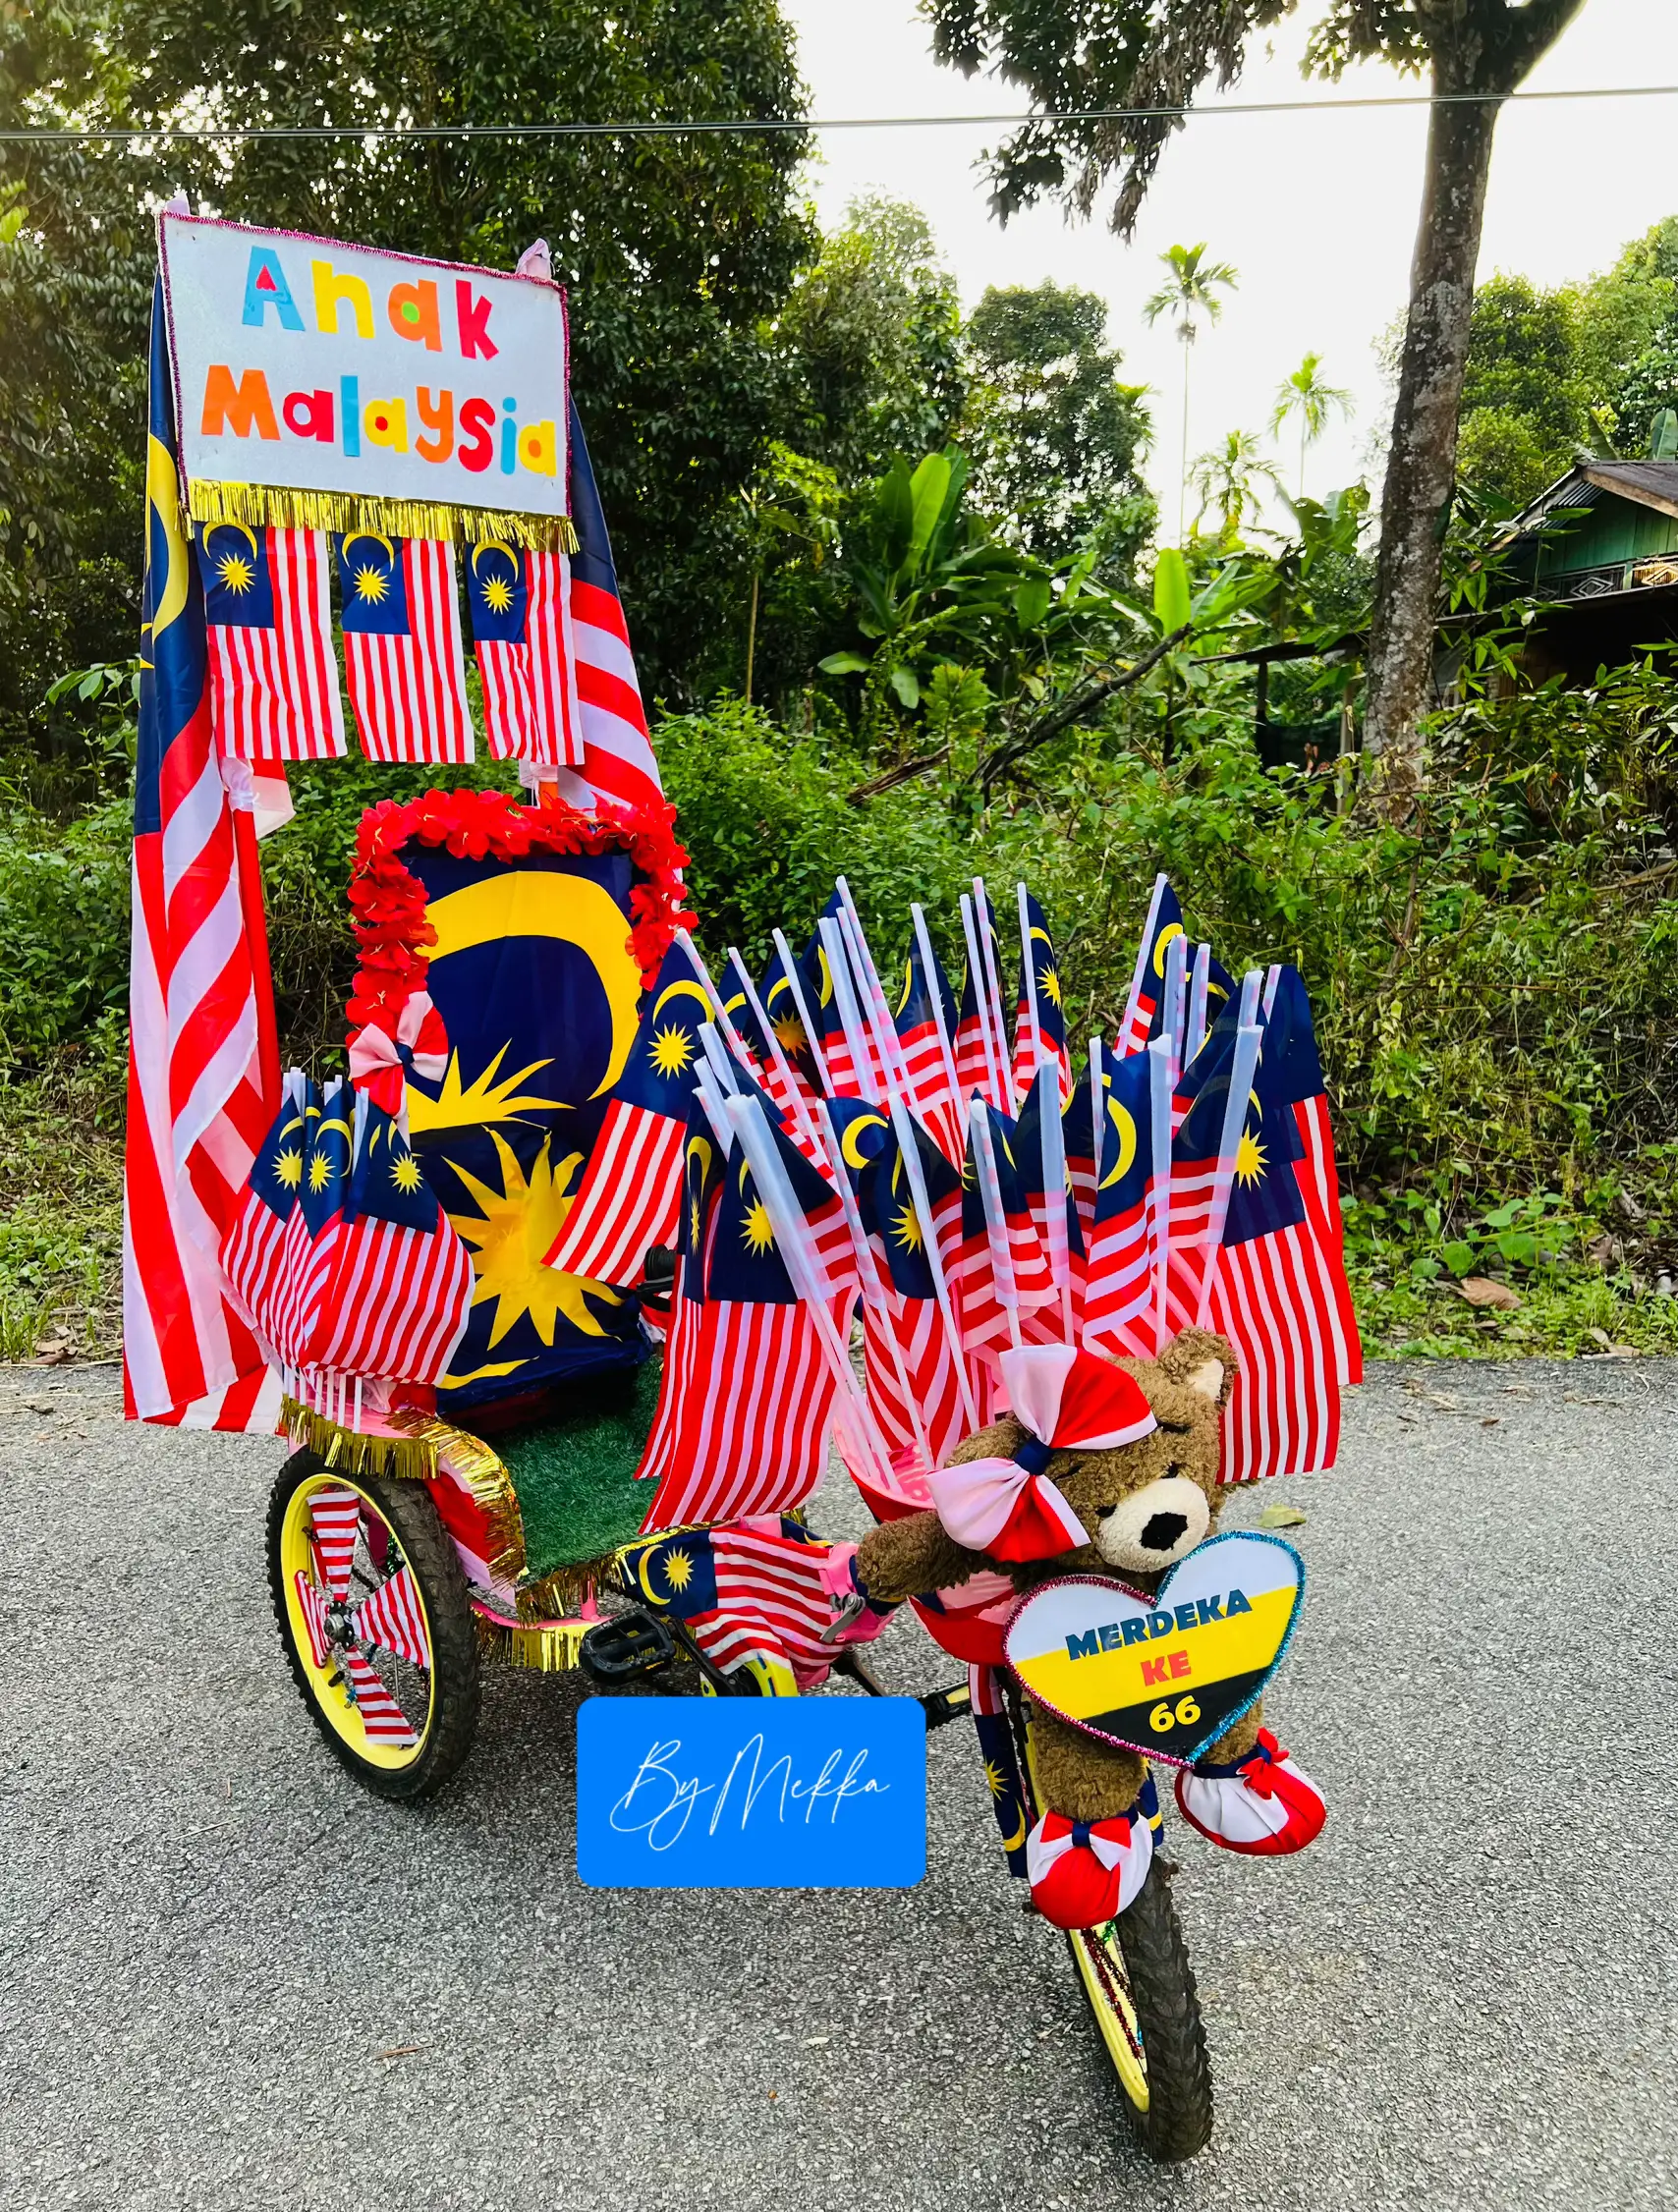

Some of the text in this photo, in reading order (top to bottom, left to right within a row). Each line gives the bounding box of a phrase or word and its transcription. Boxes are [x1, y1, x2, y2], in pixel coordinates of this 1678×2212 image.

[242, 246, 499, 360] Anak
[201, 364, 557, 477] Malaysia
[1065, 1589, 1253, 1661] MERDEKA
[1140, 1650, 1192, 1687] KE
[1148, 1695, 1202, 1733] 66
